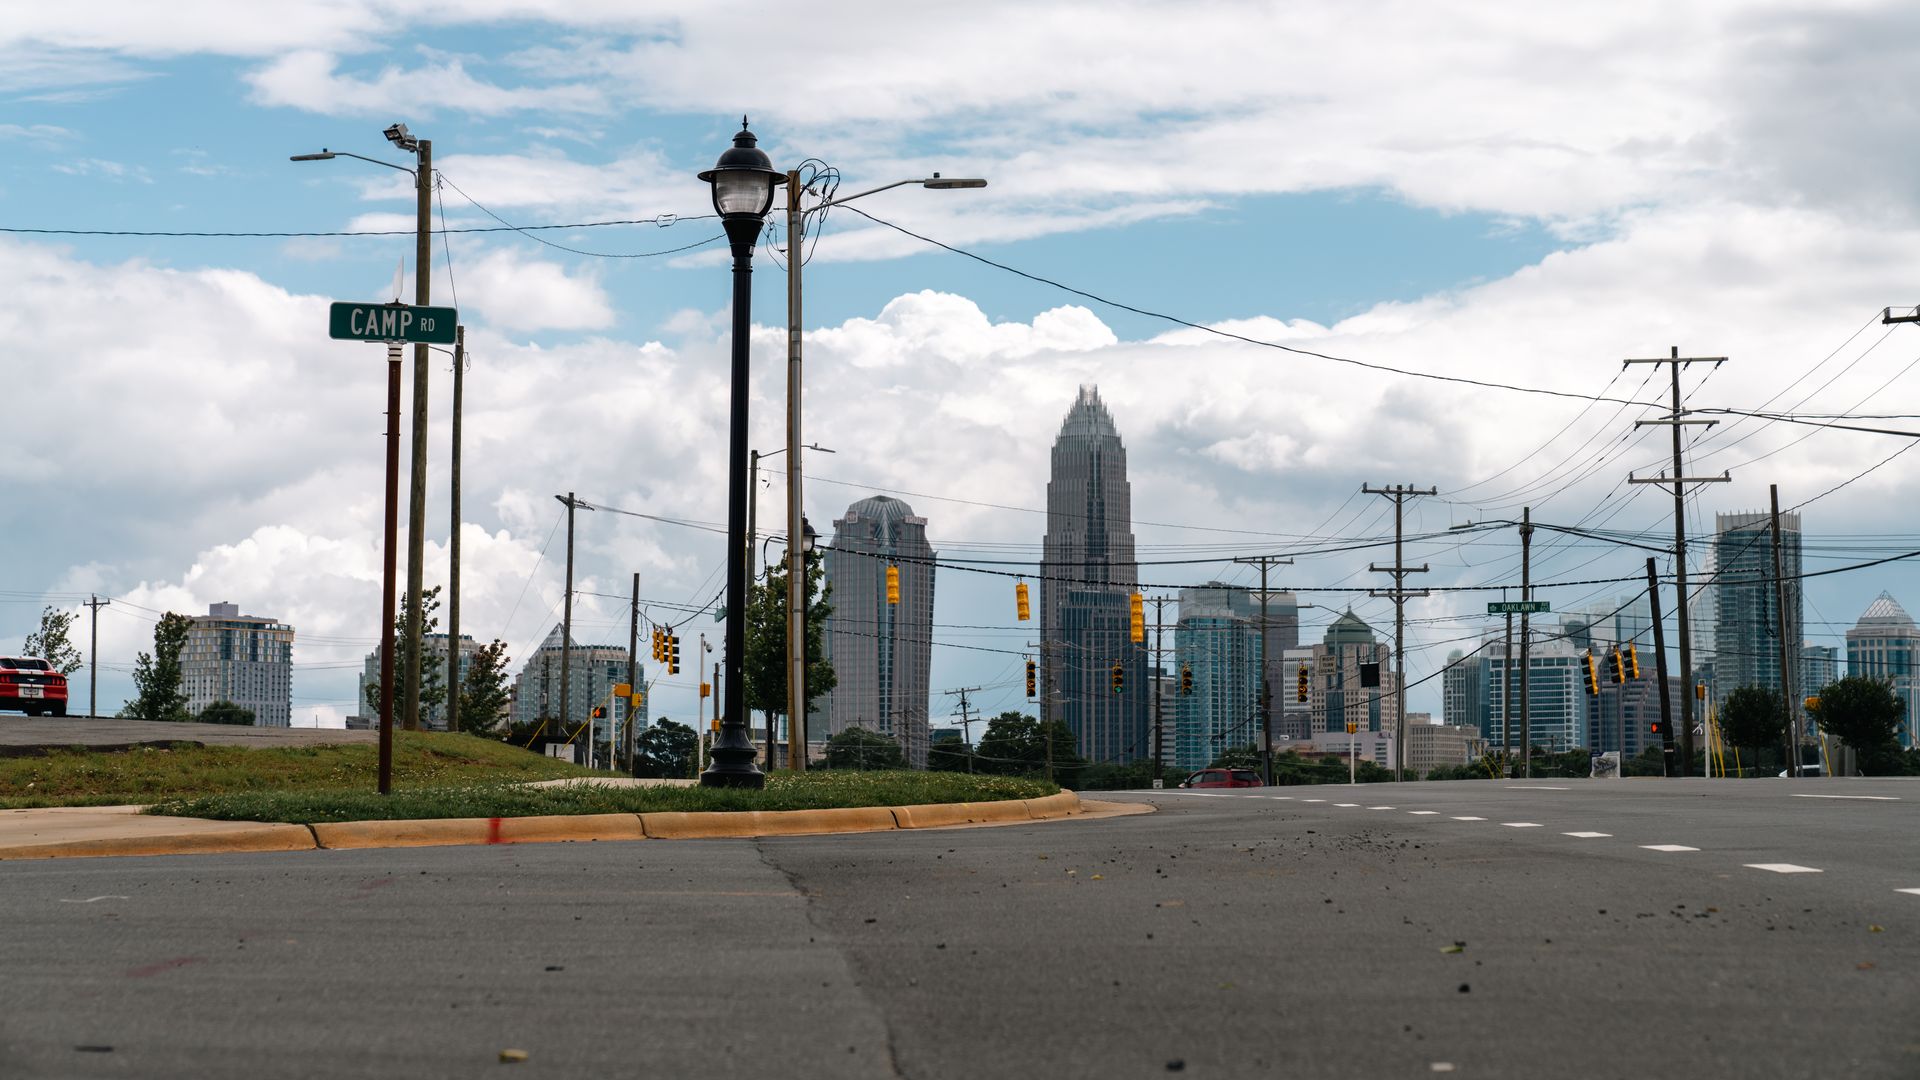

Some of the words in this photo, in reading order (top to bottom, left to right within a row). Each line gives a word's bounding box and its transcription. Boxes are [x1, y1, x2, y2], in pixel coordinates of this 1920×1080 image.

[351, 308, 413, 337] CAMP
[421, 318, 435, 332] RD
[1502, 603, 1536, 612] OAKLAWN
